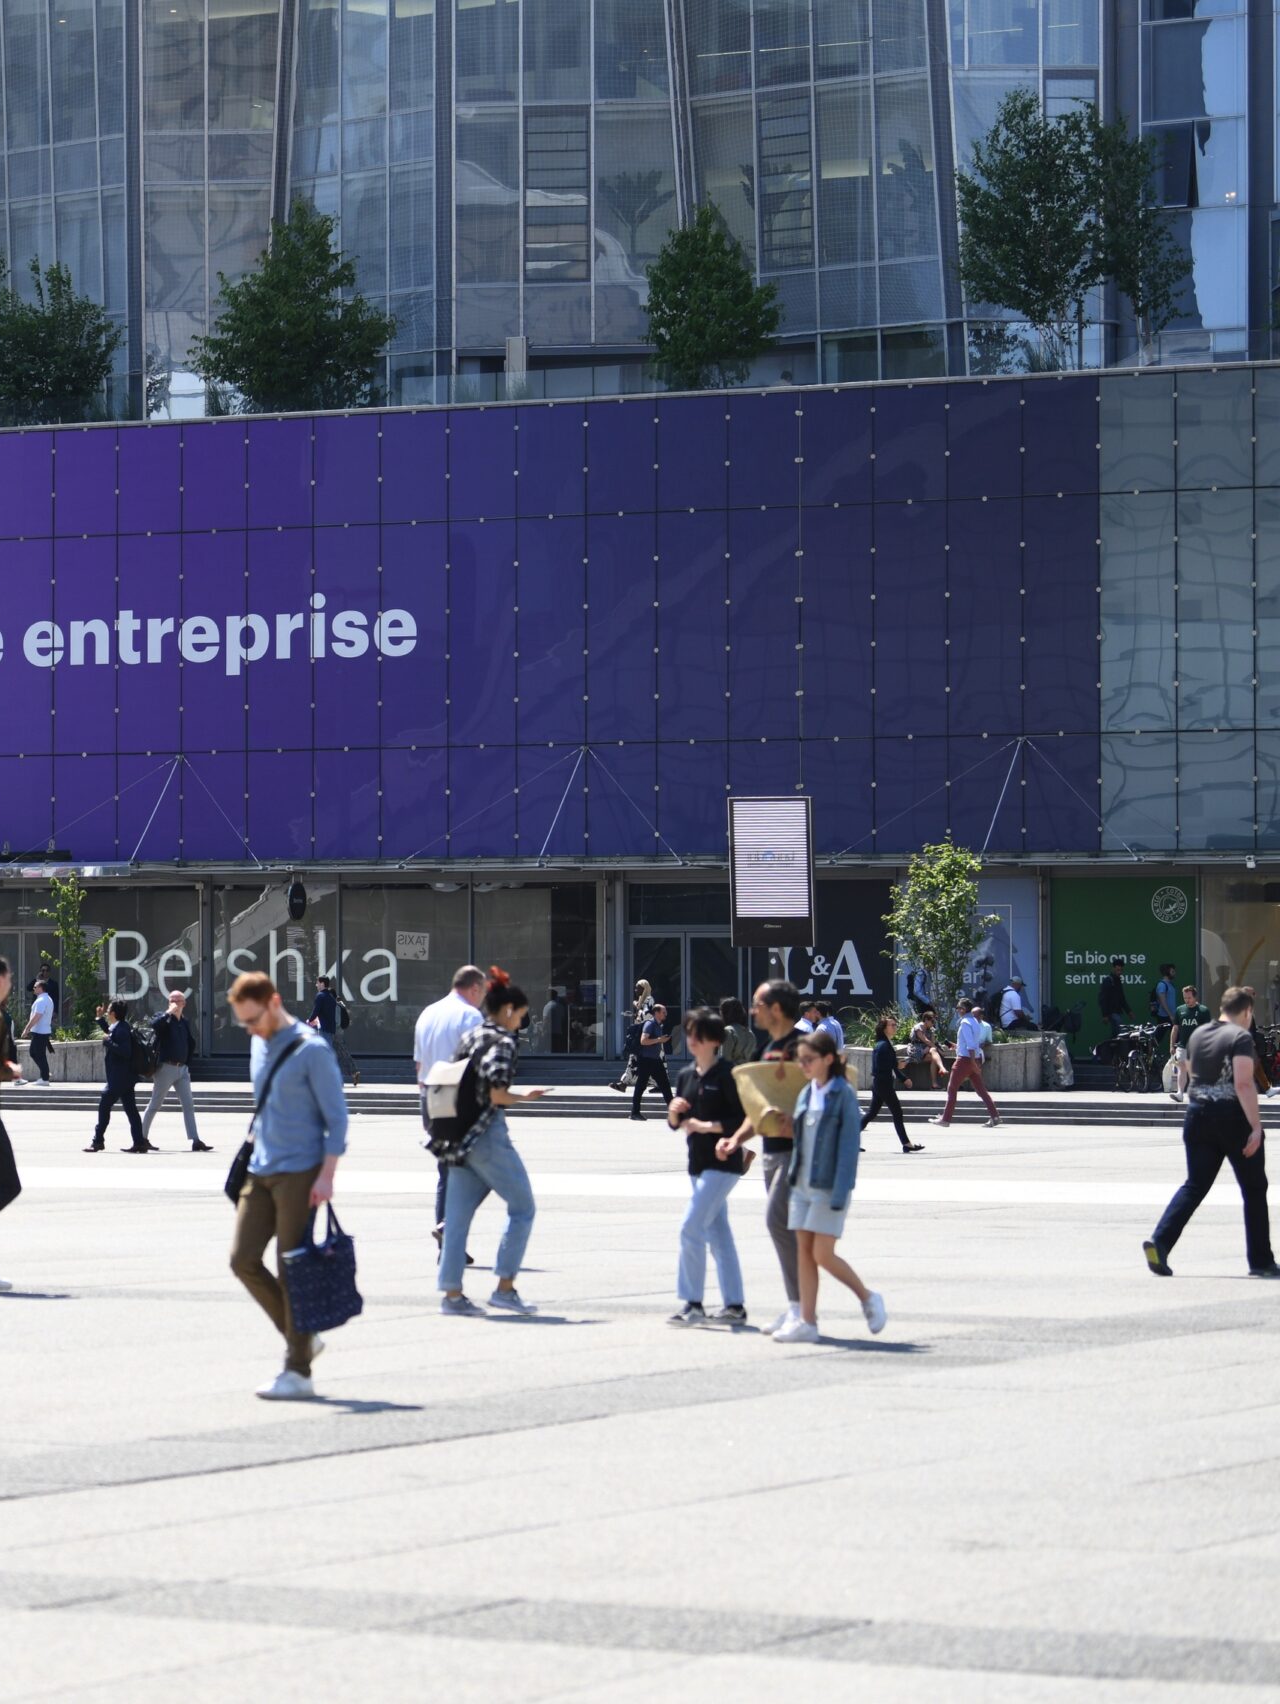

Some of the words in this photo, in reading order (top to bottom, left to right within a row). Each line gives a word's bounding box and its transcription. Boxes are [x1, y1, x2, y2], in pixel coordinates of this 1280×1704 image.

[22, 592, 418, 676] entreprise
[1065, 951, 1084, 964] En
[1086, 951, 1107, 964] bio
[1129, 954, 1146, 964] se
[1065, 972, 1096, 985] sent
[1099, 975, 1147, 985] meux.
[1181, 1018, 1198, 1027] AIA
